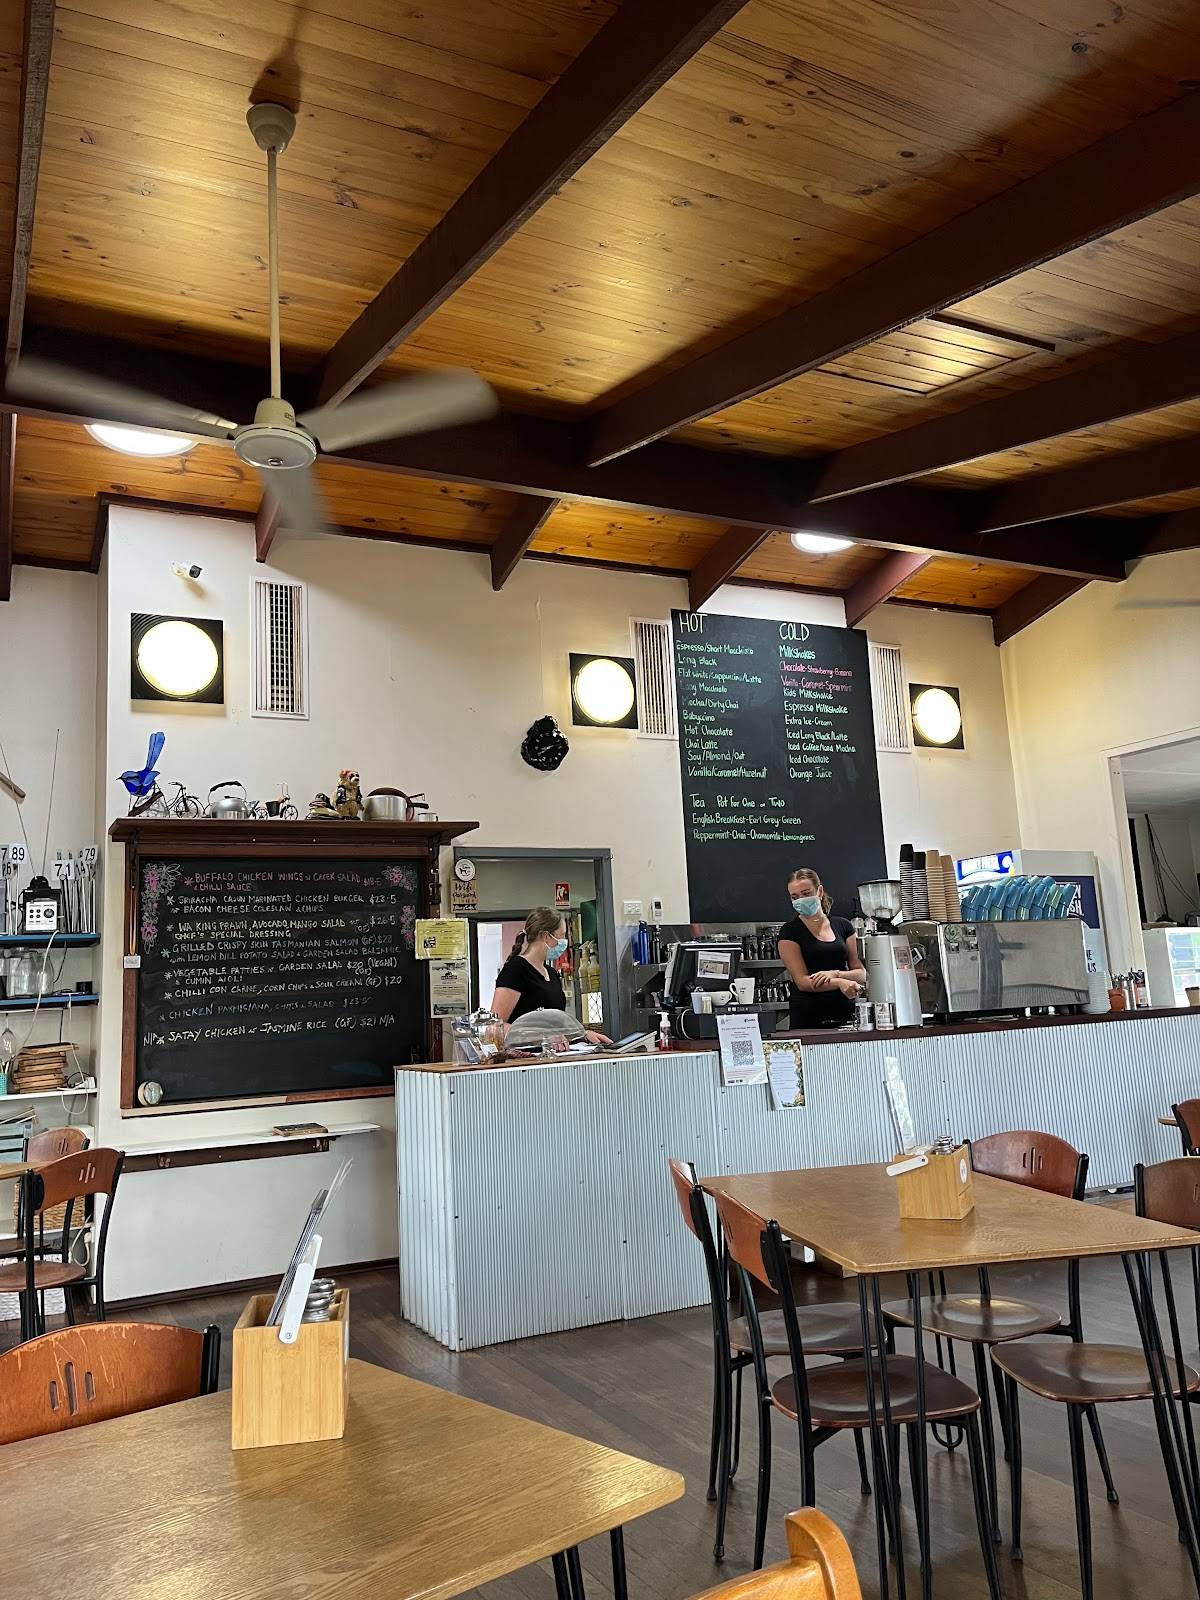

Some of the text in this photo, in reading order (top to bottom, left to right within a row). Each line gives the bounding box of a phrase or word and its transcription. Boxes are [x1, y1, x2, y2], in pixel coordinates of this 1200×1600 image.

[679, 613, 708, 634] HOT
[779, 623, 809, 641] COLD
[699, 656, 717, 666] Black
[783, 687, 797, 697] Kids
[784, 700, 814, 714] Espresso
[785, 714, 802, 725] Extra
[684, 724, 733, 736] Hot Chocolate
[786, 728, 800, 739] Iced
[800, 729, 815, 743] Long
[685, 739, 719, 750] Chai Latte
[787, 742, 801, 751] Iced
[836, 744, 857, 753] Mocha
[789, 754, 801, 764] Iced
[789, 766, 833, 782] Orange Juice
[689, 793, 705, 808] Tea
[717, 794, 728, 808] Pot
[741, 797, 756, 808] One
[768, 796, 785, 808] Two
[692, 812, 715, 827] English
[12, 846, 25, 861] 89
[85, 847, 96, 861] 79
[194, 872, 234, 882] BUFFALO
[237, 871, 273, 881] CHICKEN
[278, 872, 304, 882] WINGS
[337, 873, 361, 883] SALAD
[199, 884, 223, 892] CHILLI
[226, 883, 252, 892] SAUCE
[178, 895, 218, 905] SRIRACHA
[223, 894, 246, 903] CAJUN
[248, 894, 292, 903] MARINATED
[295, 894, 329, 903] CHICKEN
[184, 905, 212, 913] BACON
[216, 905, 251, 913] CHEESE
[252, 904, 292, 913] COLESLAW
[178, 922, 193, 932] WA
[196, 921, 217, 931] KING
[321, 918, 346, 928] SALAD
[211, 931, 245, 940] SPECIAL
[249, 929, 292, 939] DRESSING
[172, 941, 215, 953] GRILLED
[217, 940, 248, 951] CRISPY
[250, 940, 269, 949] SKIN
[271, 939, 321, 949] TASMANIAN
[325, 938, 359, 948] SALMON
[187, 952, 217, 962] LEMON
[219, 952, 237, 961] DILL
[271, 950, 295, 960] SALAD
[303, 949, 333, 958] GARDEN
[335, 947, 358, 957] SALAD
[173, 966, 227, 978] VEGETABLE
[230, 965, 265, 975] PATTIES
[278, 962, 313, 972] GARDEN
[315, 960, 343, 970] SALAD
[346, 960, 364, 970] $20
[367, 957, 398, 968] (VEGAN)
[185, 977, 212, 985] CUMIN
[174, 988, 206, 998] CHILLI
[209, 986, 228, 995] CON
[263, 983, 285, 992] CORN
[168, 1003, 214, 1020] CHICKEN
[307, 1000, 335, 1009] SALAD
[168, 1028, 202, 1042] SATAY
[204, 1025, 246, 1038] CHICKEN
[260, 1021, 303, 1034] JASMINE
[306, 1020, 328, 1030] RICE
[335, 1016, 357, 1029] (GF)
